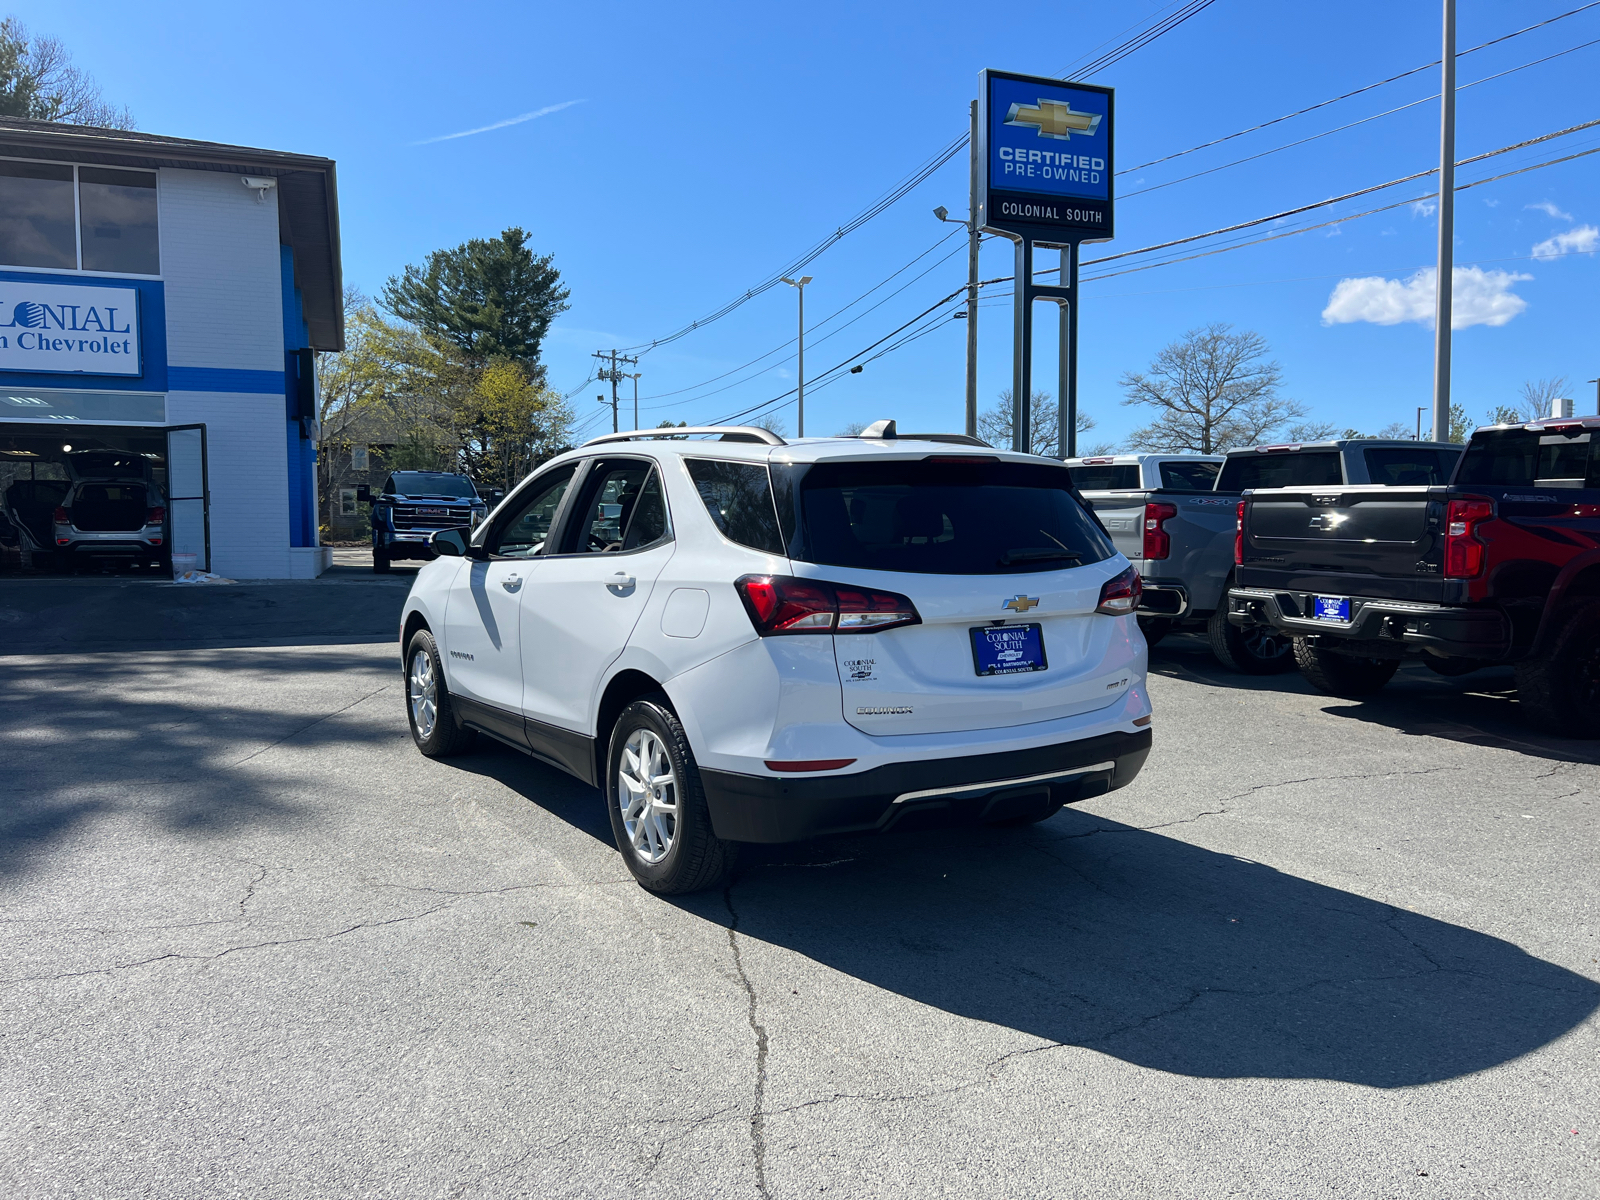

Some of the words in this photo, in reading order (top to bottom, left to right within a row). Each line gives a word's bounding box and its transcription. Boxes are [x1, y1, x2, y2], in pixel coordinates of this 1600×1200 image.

[999, 146, 1105, 171] CERTIFIED
[1004, 162, 1100, 184] PRE-OWNED
[1002, 202, 1060, 219] COLONIAL
[1066, 208, 1102, 223] SOUTH
[16, 331, 131, 355] Chevrolet
[986, 632, 1027, 643] COLONIAL
[994, 641, 1023, 651] SOUTH
[843, 659, 877, 667] COLONIAL
[856, 705, 914, 716] EQUINOX
